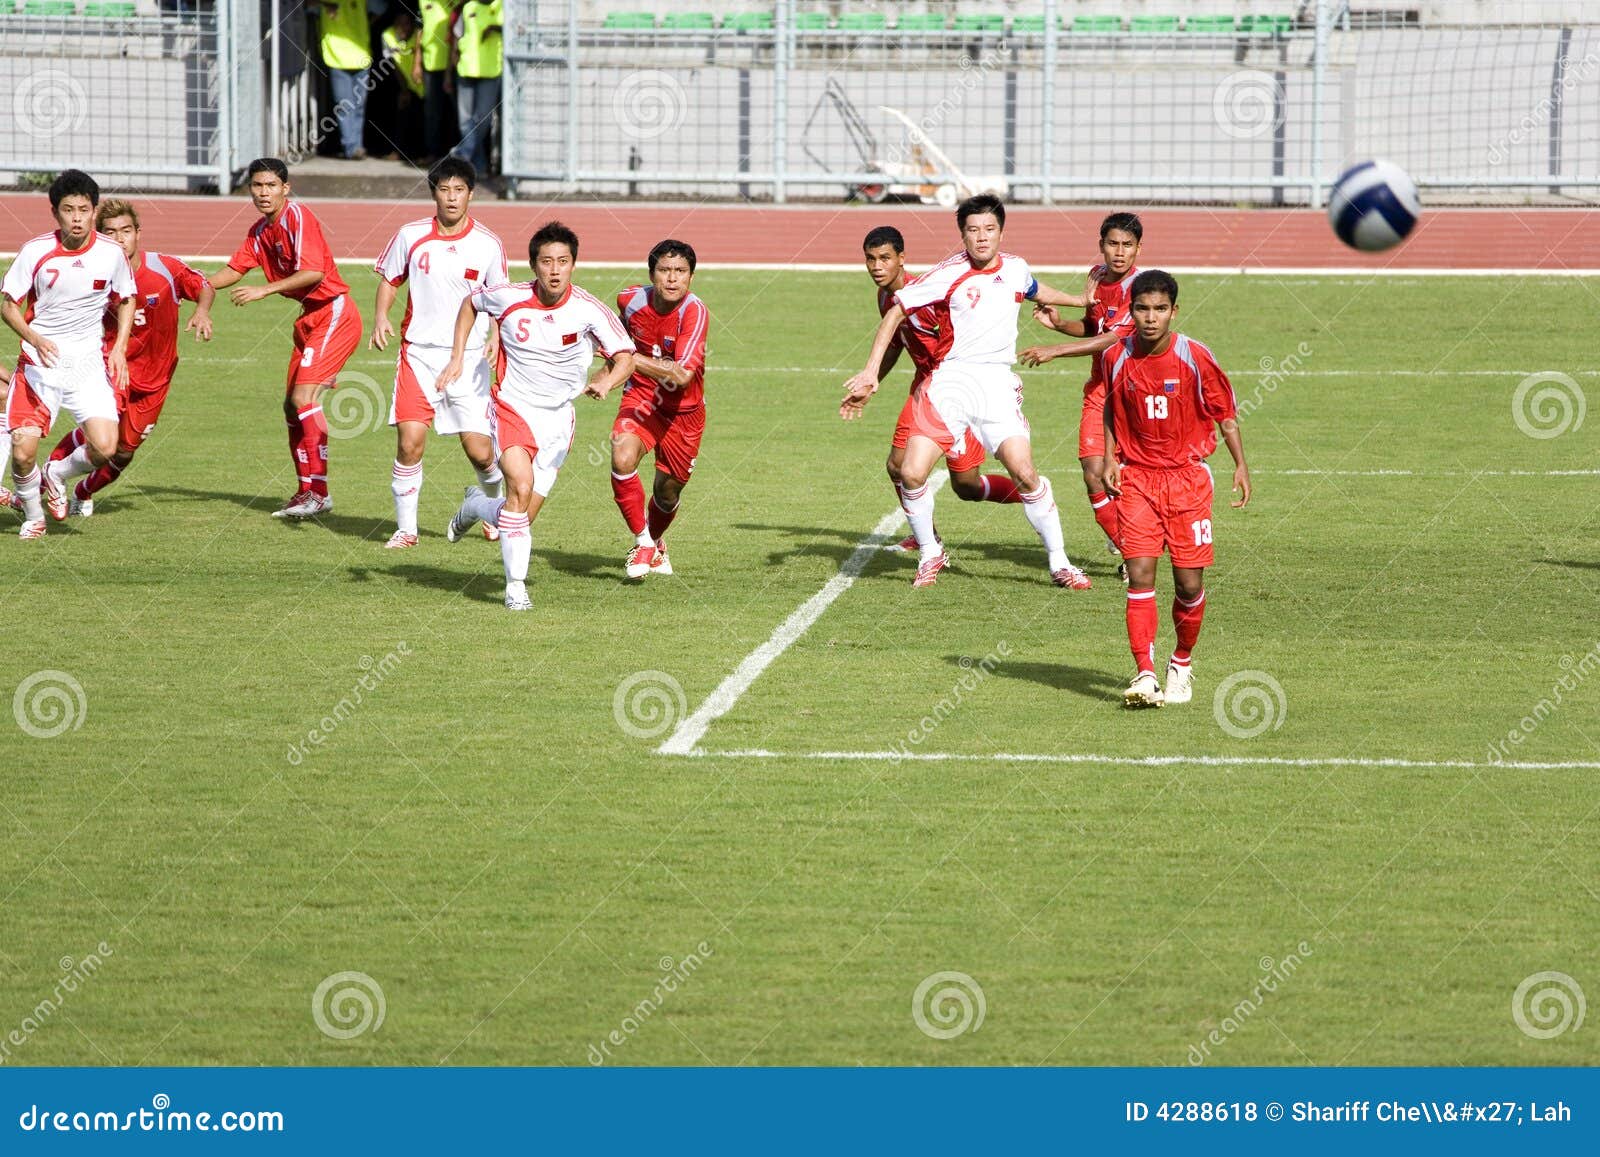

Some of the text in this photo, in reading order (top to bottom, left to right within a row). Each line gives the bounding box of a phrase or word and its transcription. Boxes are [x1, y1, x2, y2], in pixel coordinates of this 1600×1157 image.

[418, 251, 430, 275] 4
[46, 268, 60, 289] 7
[966, 286, 981, 309] 9
[134, 308, 146, 326] 5
[515, 318, 531, 343] 5
[300, 346, 315, 368] 3
[1144, 394, 1169, 420] 13
[1191, 518, 1213, 547] 13
